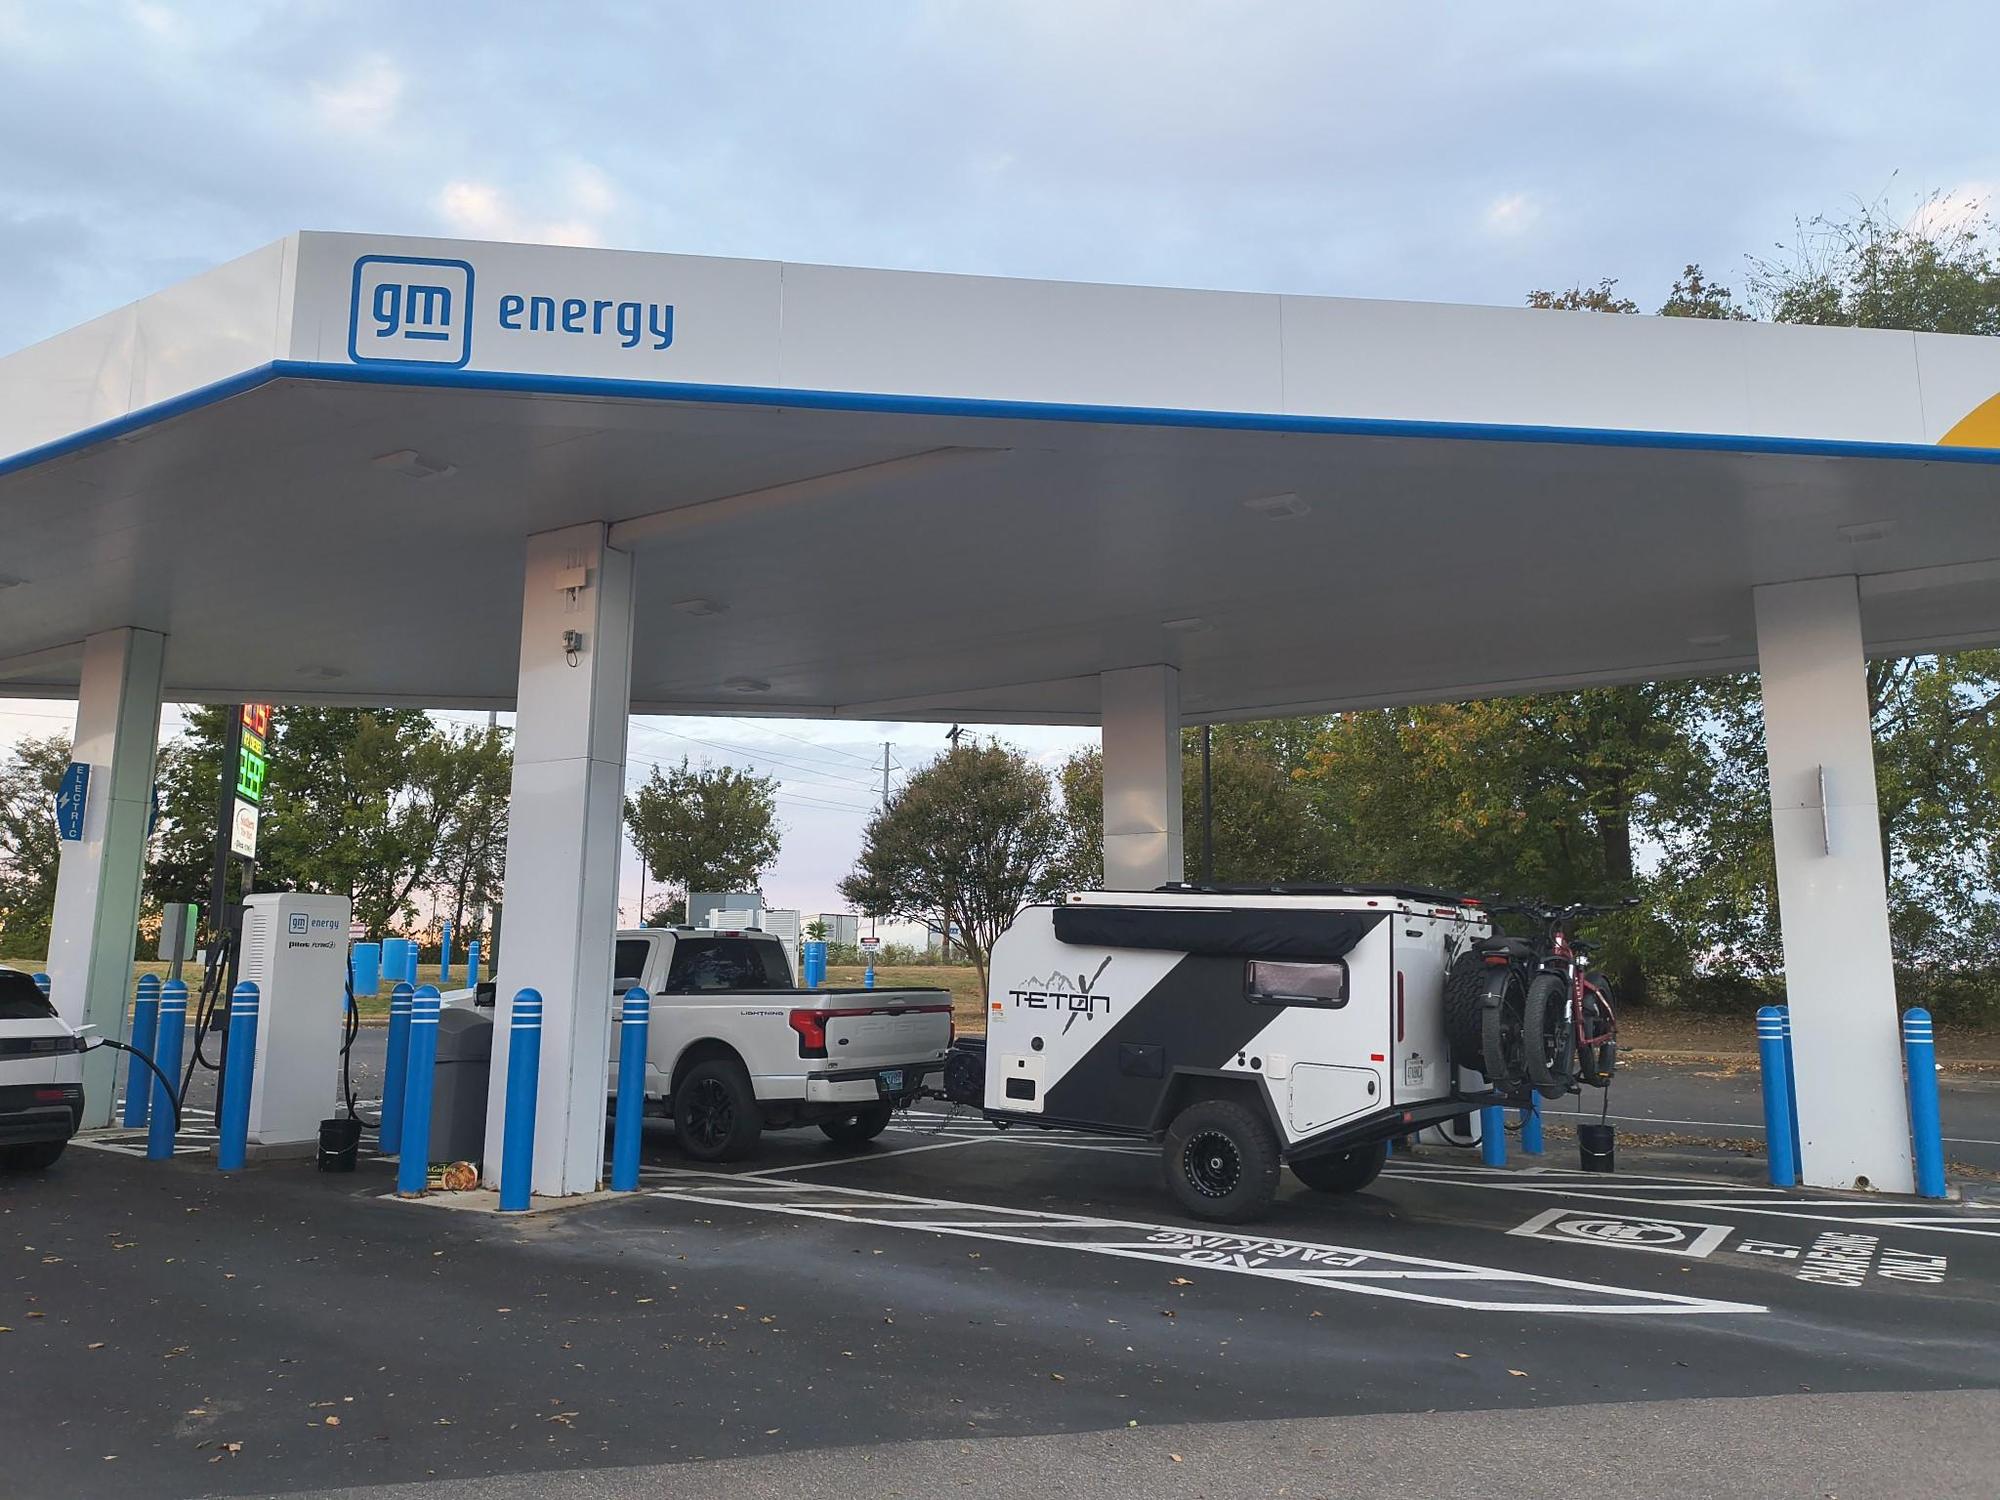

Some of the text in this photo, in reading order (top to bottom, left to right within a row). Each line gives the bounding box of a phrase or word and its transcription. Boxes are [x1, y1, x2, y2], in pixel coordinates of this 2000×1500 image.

[373, 282, 675, 350] gm energy
[68, 765, 85, 838] ELECTRIC
[292, 918, 339, 929] gm energy
[1009, 990, 1110, 1013] TETON
[1146, 1231, 1367, 1268] PARKING
[1736, 1238, 1801, 1259] EV
[1795, 1231, 1880, 1288] CHARGING
[1877, 1247, 1948, 1283] ONLY
